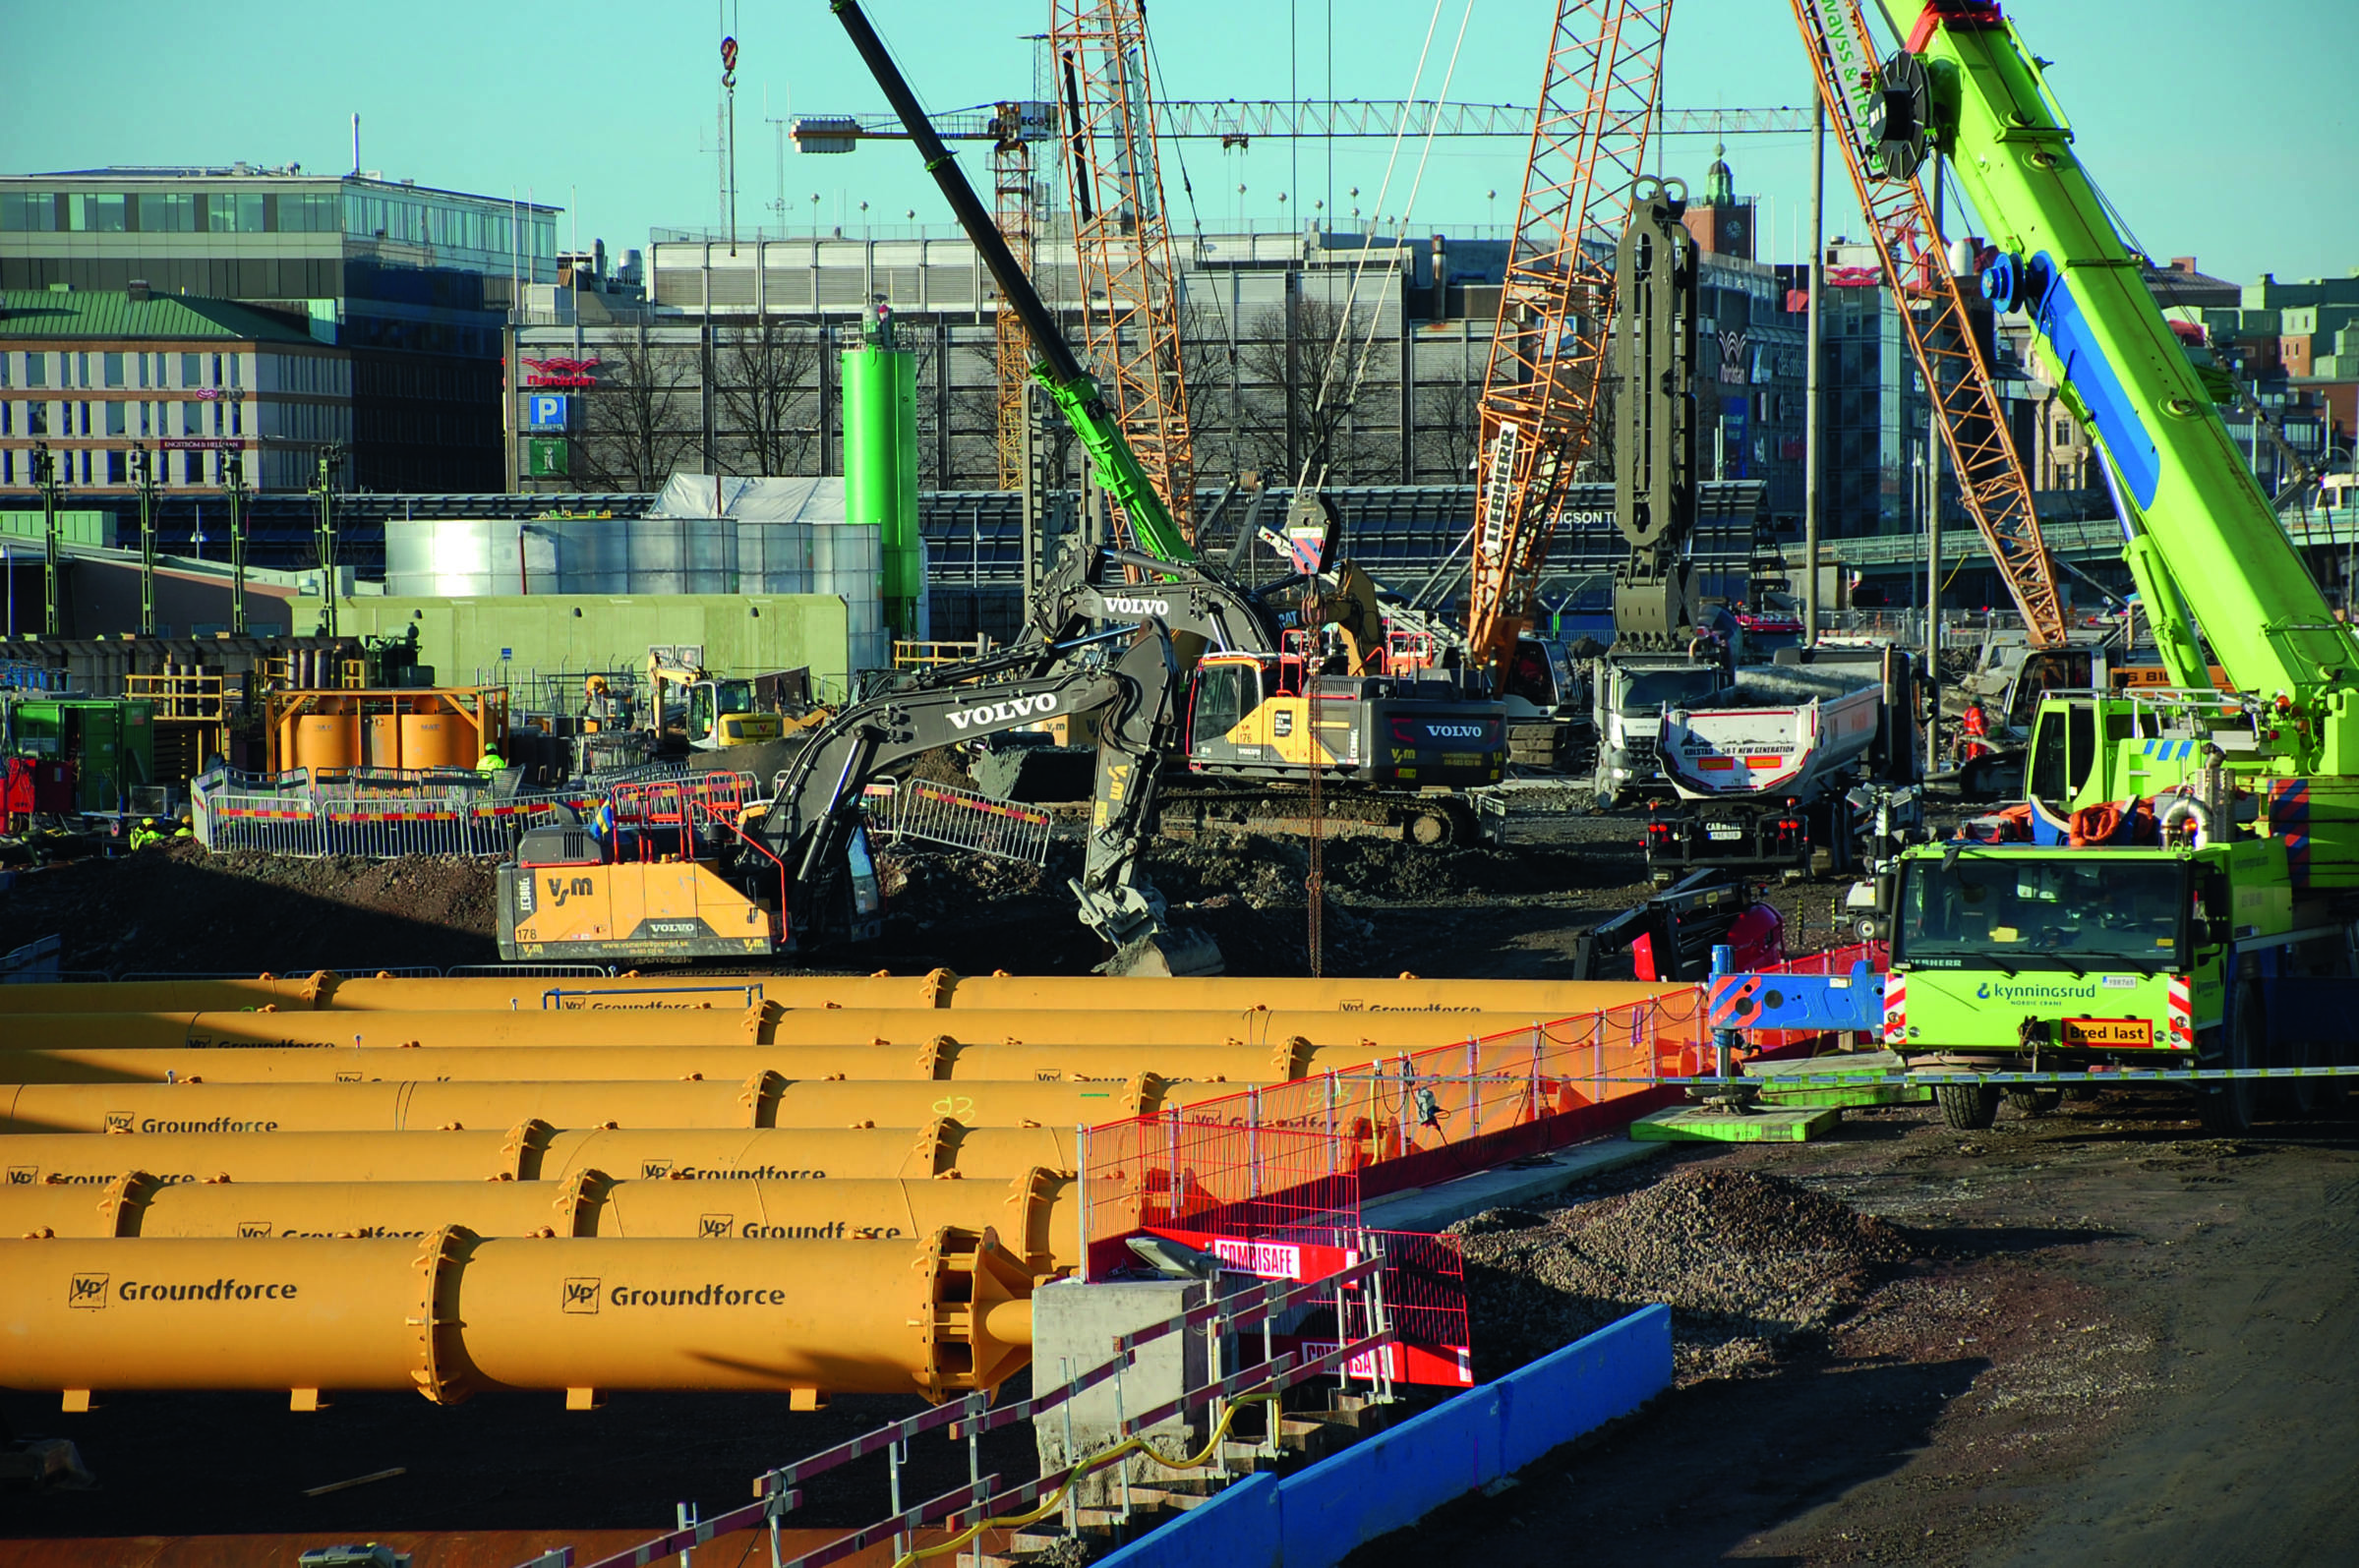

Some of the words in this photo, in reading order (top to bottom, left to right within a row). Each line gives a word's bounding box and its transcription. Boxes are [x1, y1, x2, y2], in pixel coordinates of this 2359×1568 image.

[538, 397, 558, 424] P
[1486, 430, 1515, 543] LIEBHERR
[1103, 598, 1169, 614] VOLVO
[946, 693, 1057, 729] VOLVO
[1427, 726, 1482, 737] VOLVO
[516, 929, 537, 941] 178
[650, 923, 694, 933] VOLVO
[1994, 983, 2095, 1000] kynningsrud
[2070, 1026, 2107, 1039] Bred
[2114, 1027, 2145, 1040] last
[142, 1117, 278, 1133] Groundforce
[1219, 1244, 1293, 1275] COMBISAFE
[119, 1279, 298, 1301] Groundforce
[611, 1284, 786, 1306] Groundforce
